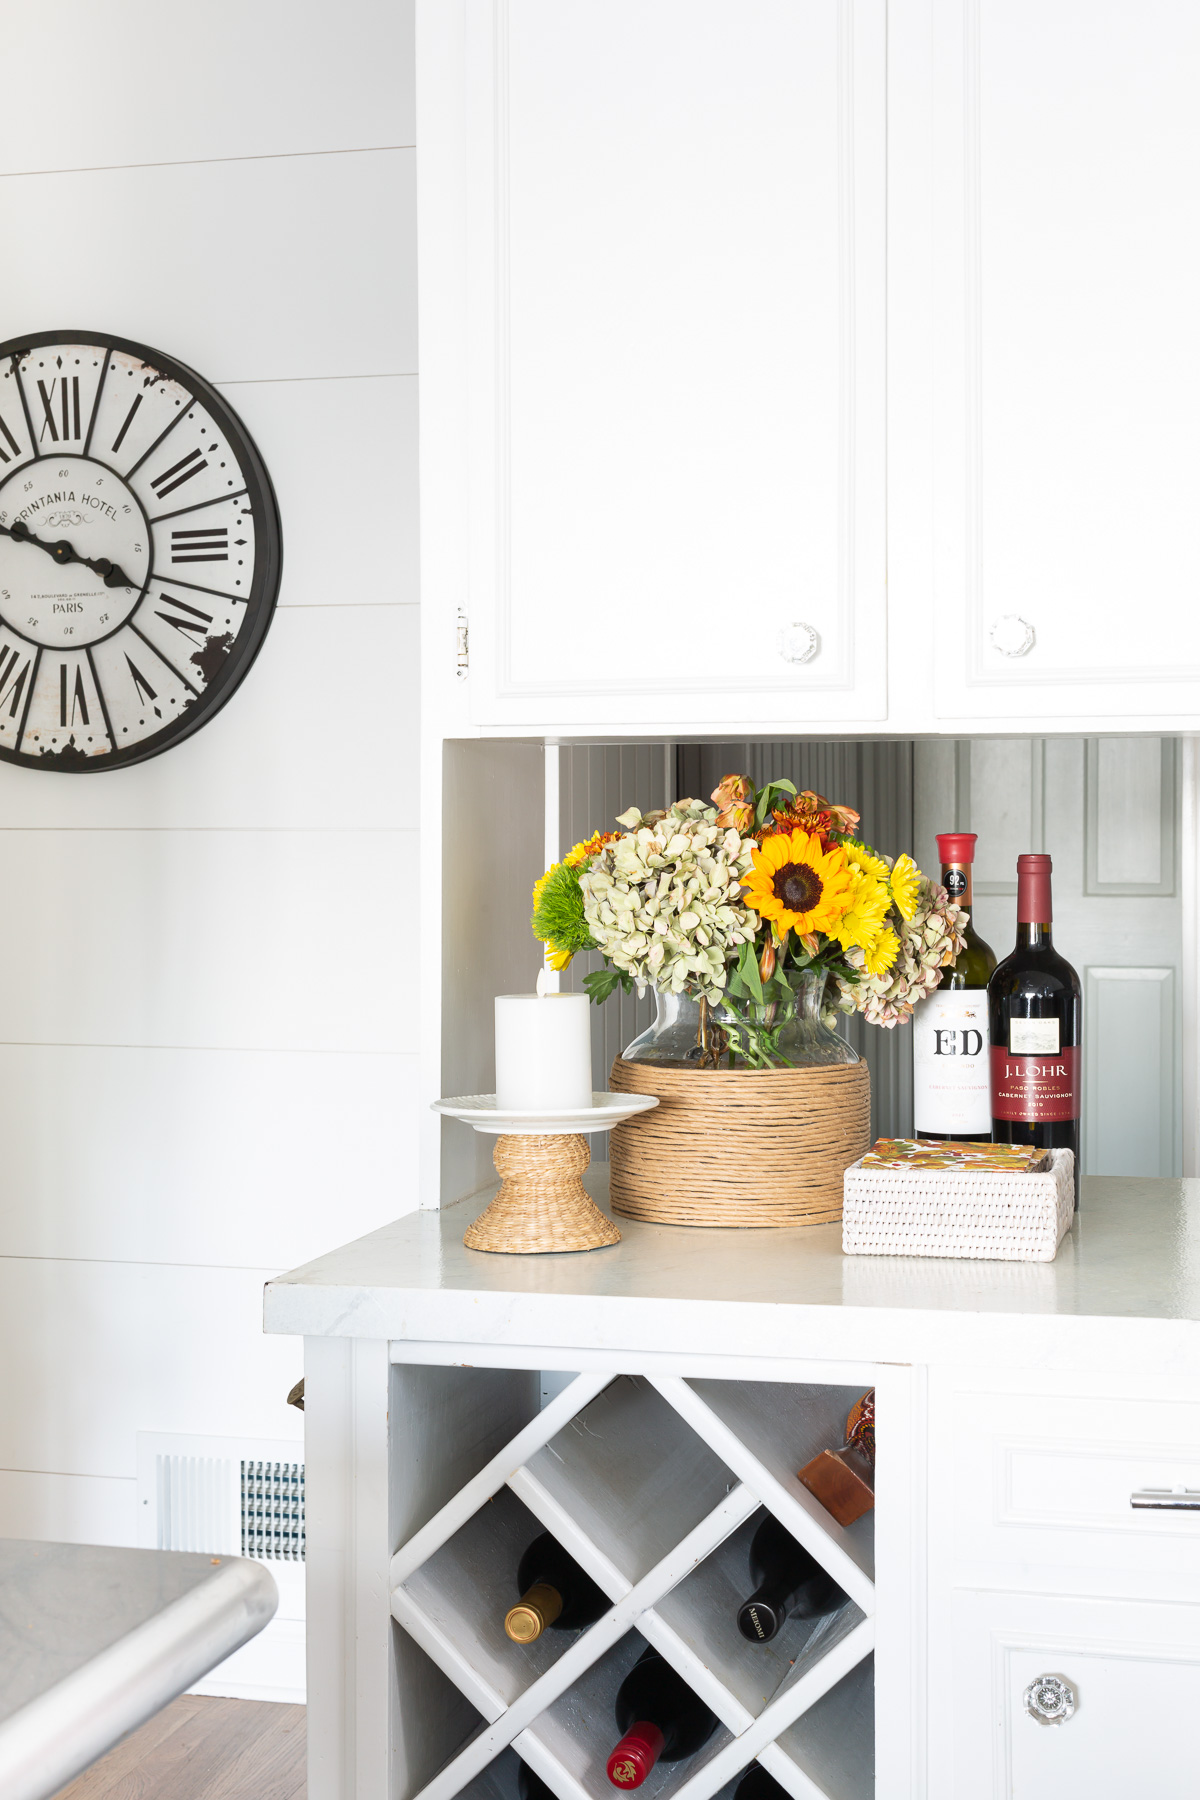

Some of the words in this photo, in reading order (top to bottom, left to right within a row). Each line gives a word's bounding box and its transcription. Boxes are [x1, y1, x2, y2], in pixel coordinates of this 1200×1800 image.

[37, 376, 81, 442] XII
[111, 393, 144, 453] I
[58, 469, 69, 478] 60
[150, 447, 208, 500] II
[23, 480, 34, 492] 55
[96, 478, 104, 486] 5
[81, 493, 117, 522] HOTEL
[121, 504, 132, 514] 10
[134, 543, 142, 553] 15
[171, 528, 228, 563] III
[53, 602, 84, 613] PARIS
[27, 617, 39, 627] 35
[99, 613, 110, 624] 25
[63, 626, 75, 635] 30
[123, 650, 158, 706] V
[949, 875, 960, 886] 92
[933, 1029, 983, 1056] ED
[998, 1091, 1032, 1099] CABERNET
[748, 1607, 766, 1639] MEIOMI
